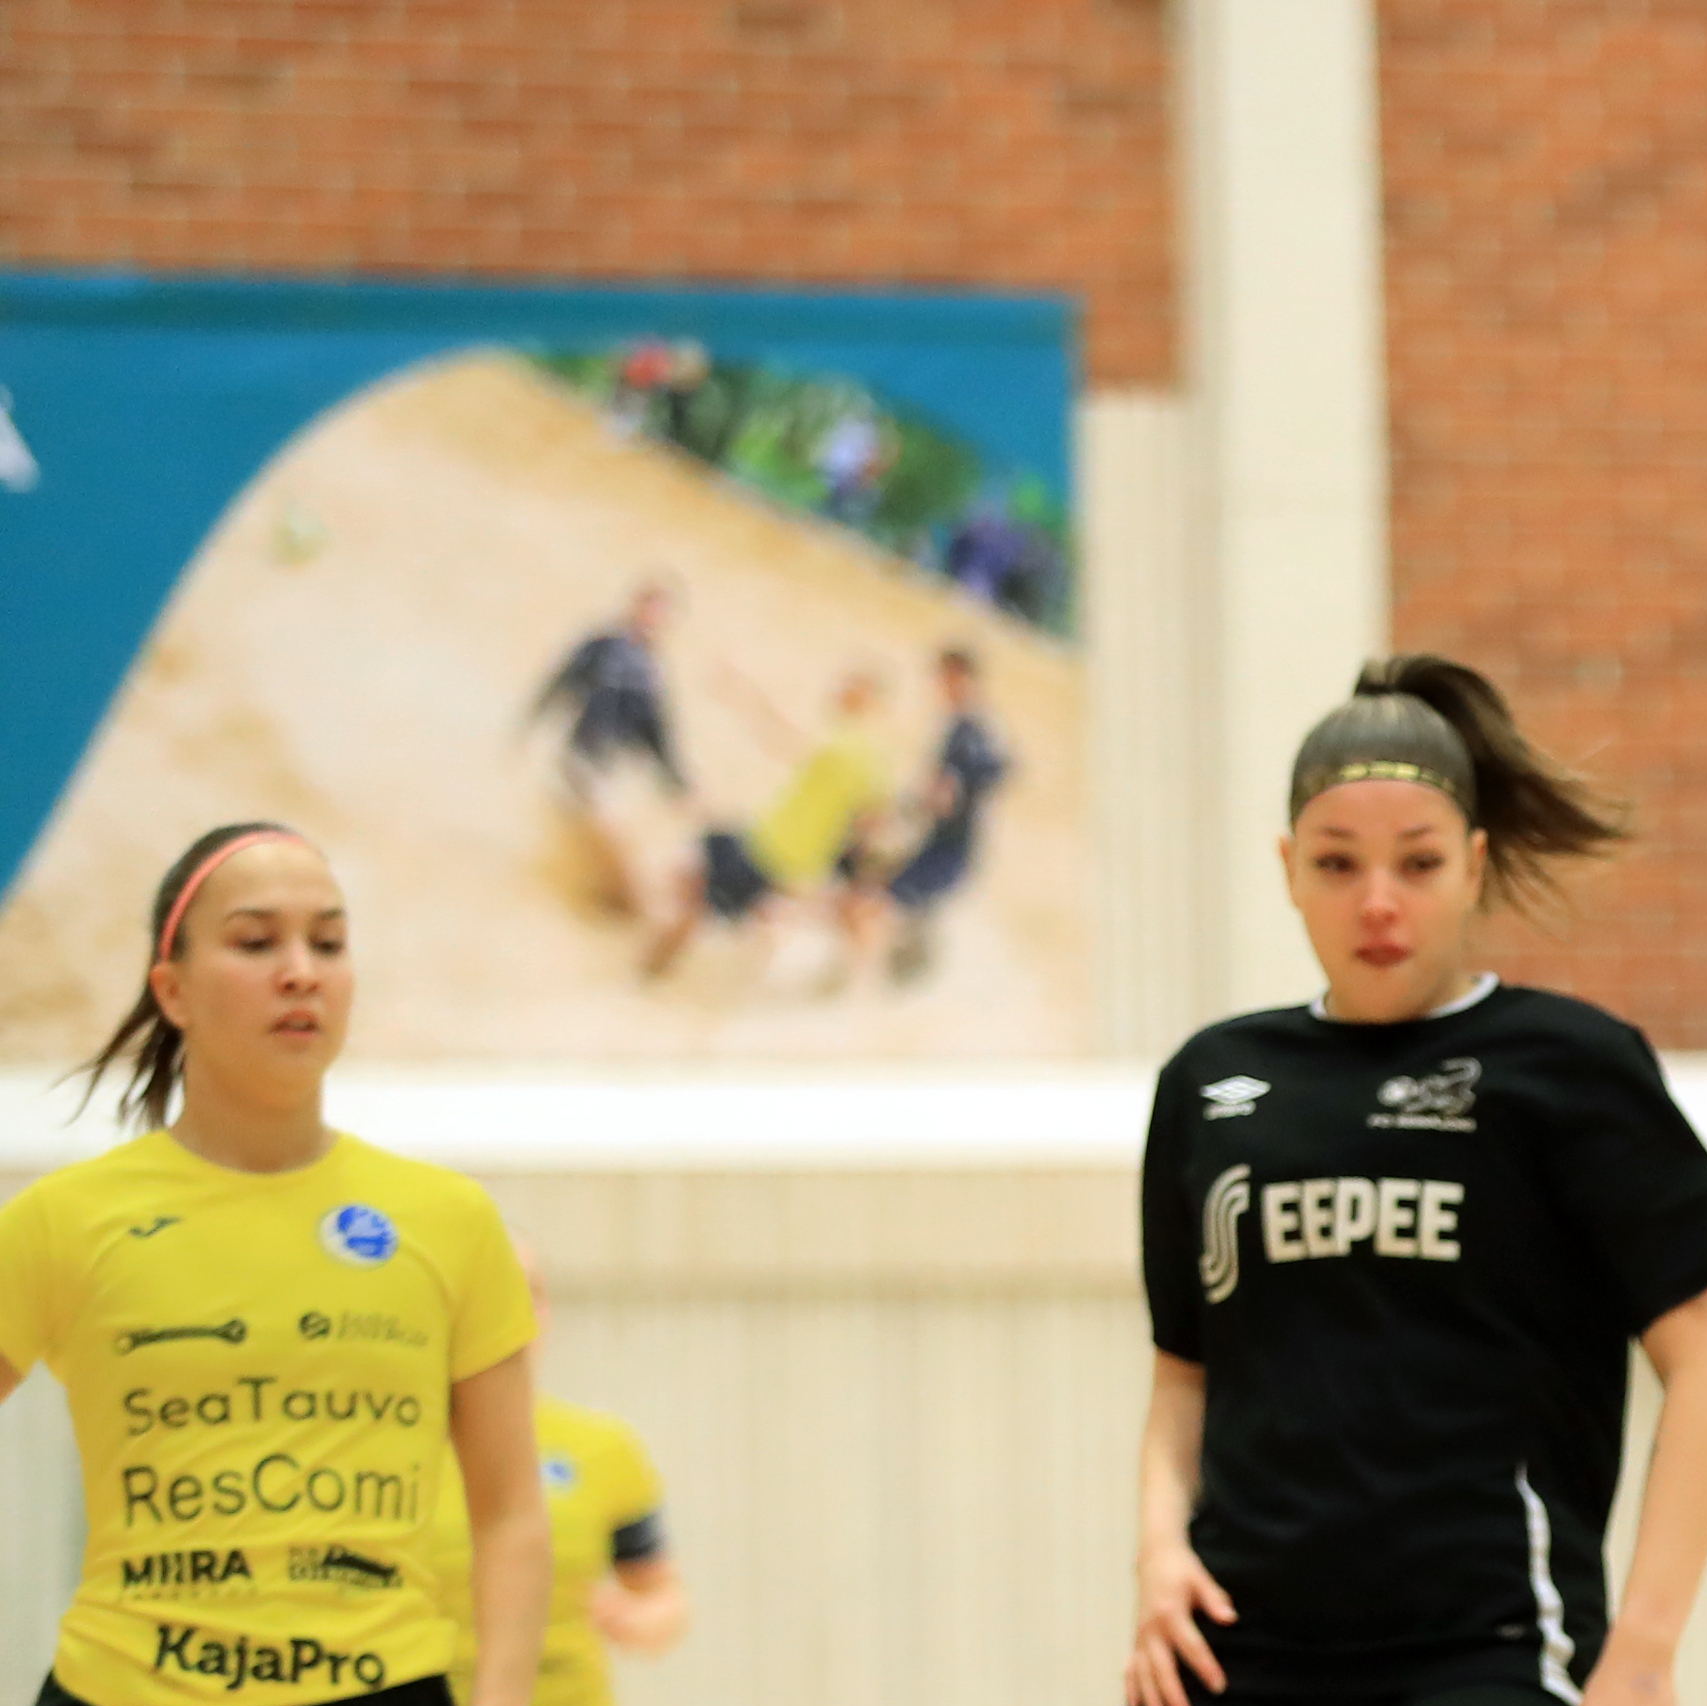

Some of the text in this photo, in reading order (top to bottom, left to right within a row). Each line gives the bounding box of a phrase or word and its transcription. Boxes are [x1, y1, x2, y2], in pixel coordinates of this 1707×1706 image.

[1260, 1175, 1466, 1264] EEPEE
[121, 1374, 421, 1437] SeaTauvo
[121, 1452, 422, 1527] ResComi
[154, 1623, 387, 1691] KajaPro
